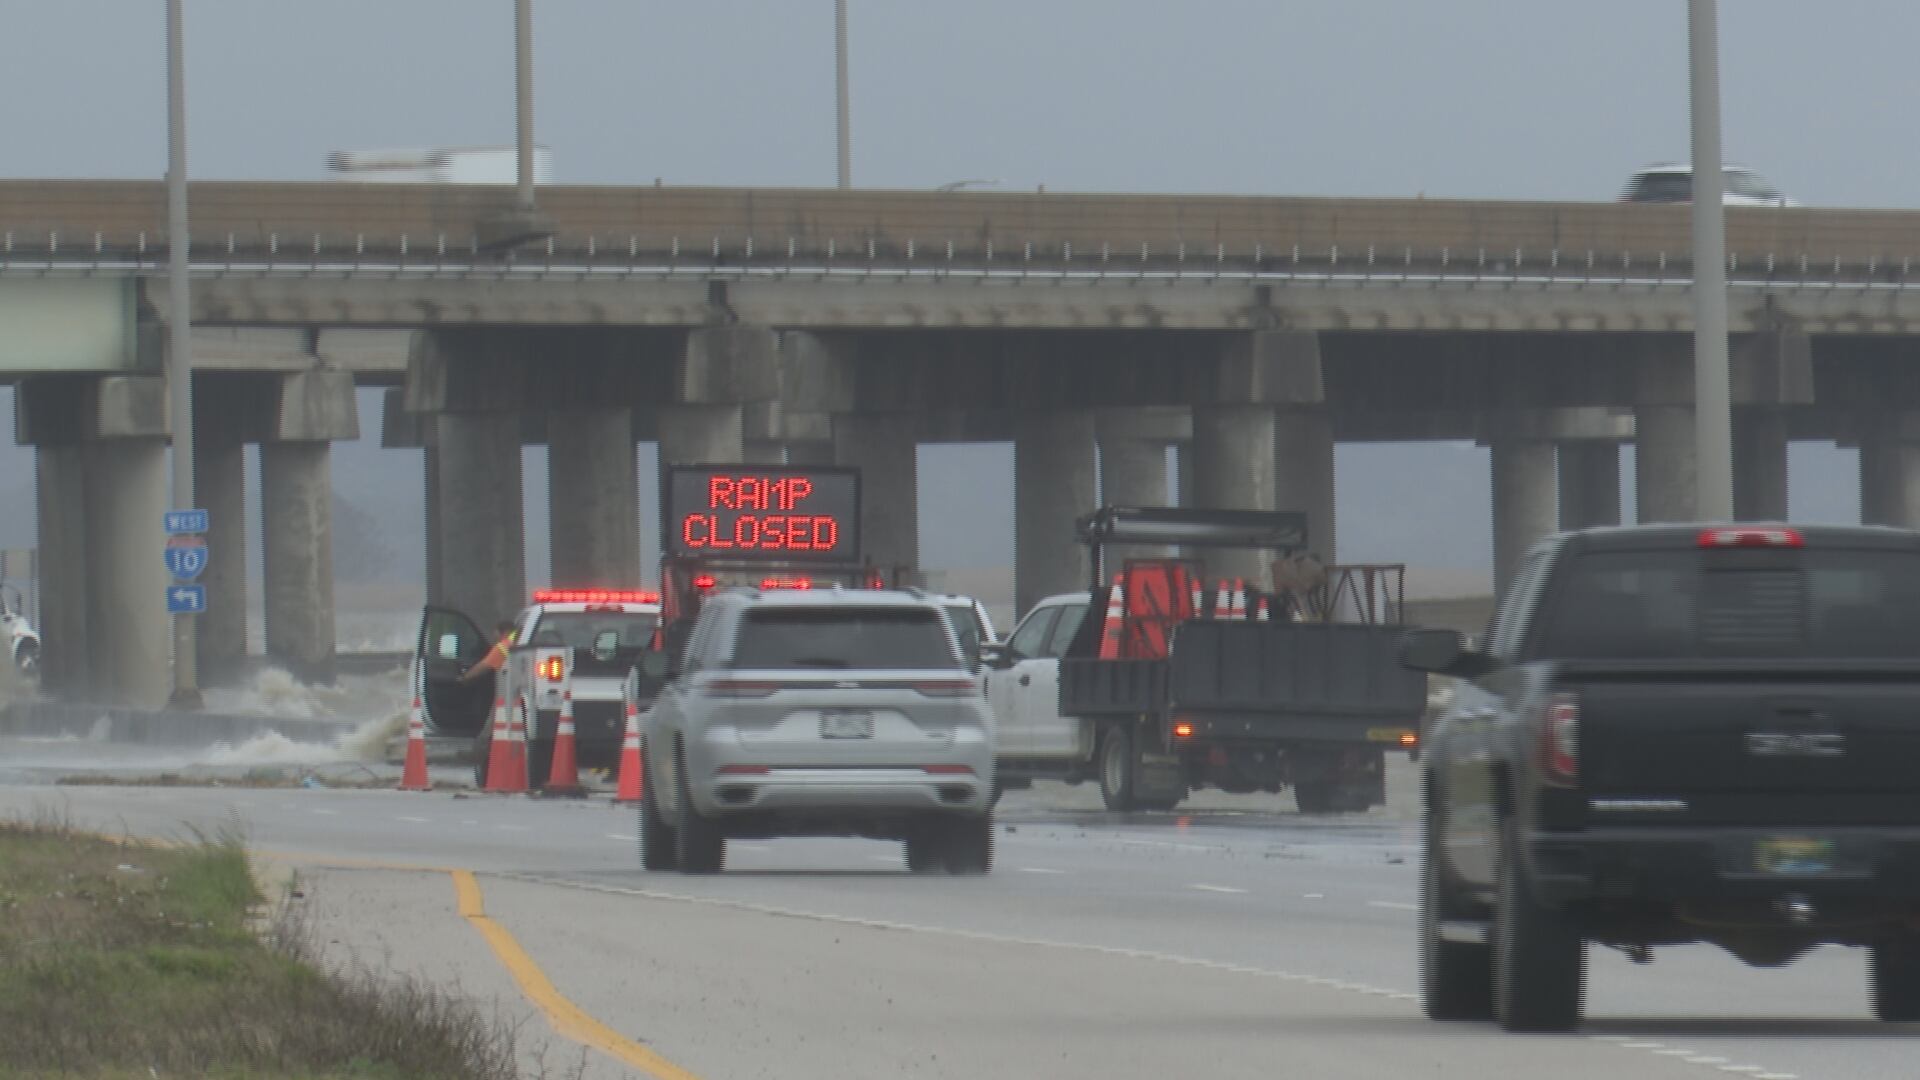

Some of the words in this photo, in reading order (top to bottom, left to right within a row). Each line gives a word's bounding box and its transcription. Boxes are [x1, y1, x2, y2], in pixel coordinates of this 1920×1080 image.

[708, 476, 812, 510] RAMP
[168, 514, 203, 530] WEST
[683, 513, 838, 550] CLOSED
[172, 551, 200, 572] 10
[1745, 733, 1846, 756] GMC
